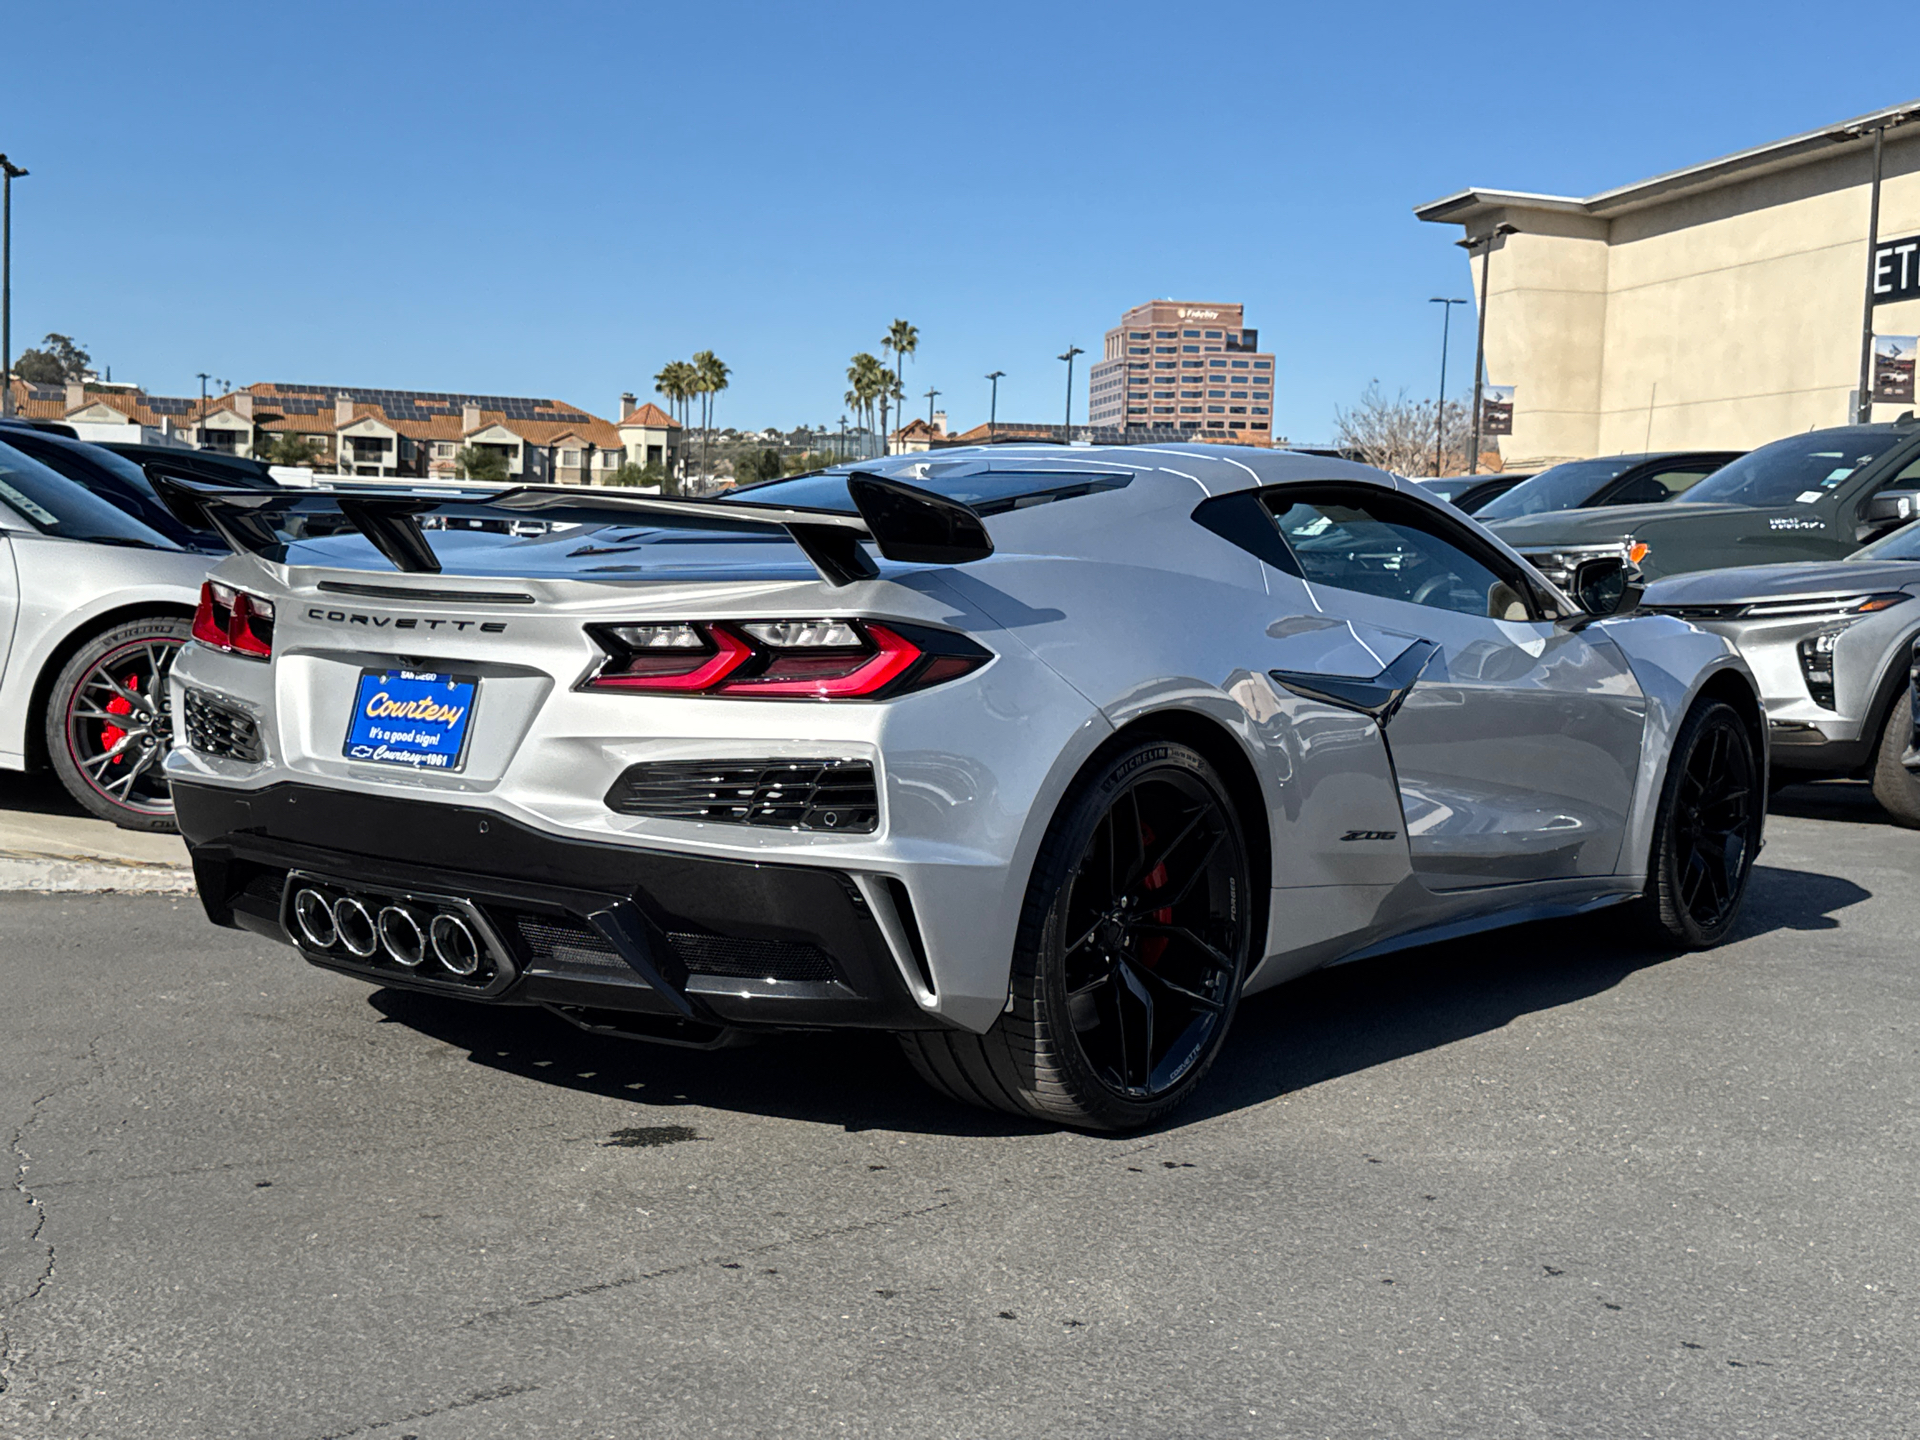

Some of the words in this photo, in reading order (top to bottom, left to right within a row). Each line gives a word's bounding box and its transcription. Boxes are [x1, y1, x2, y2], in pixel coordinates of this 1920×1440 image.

[1873, 243, 1920, 294] ET
[117, 625, 173, 640] MICHELIN
[308, 608, 508, 633] CORVETTE
[366, 692, 465, 730] Courtesy
[369, 726, 384, 740] It's
[383, 731, 391, 740] a
[390, 729, 416, 744] good
[415, 731, 441, 748] sign!
[373, 744, 422, 769] Courtesy
[426, 753, 449, 768] 1961
[1115, 747, 1167, 781] MICHELIN
[1339, 830, 1398, 841] Z06
[1169, 1043, 1201, 1080] CORVETTE
